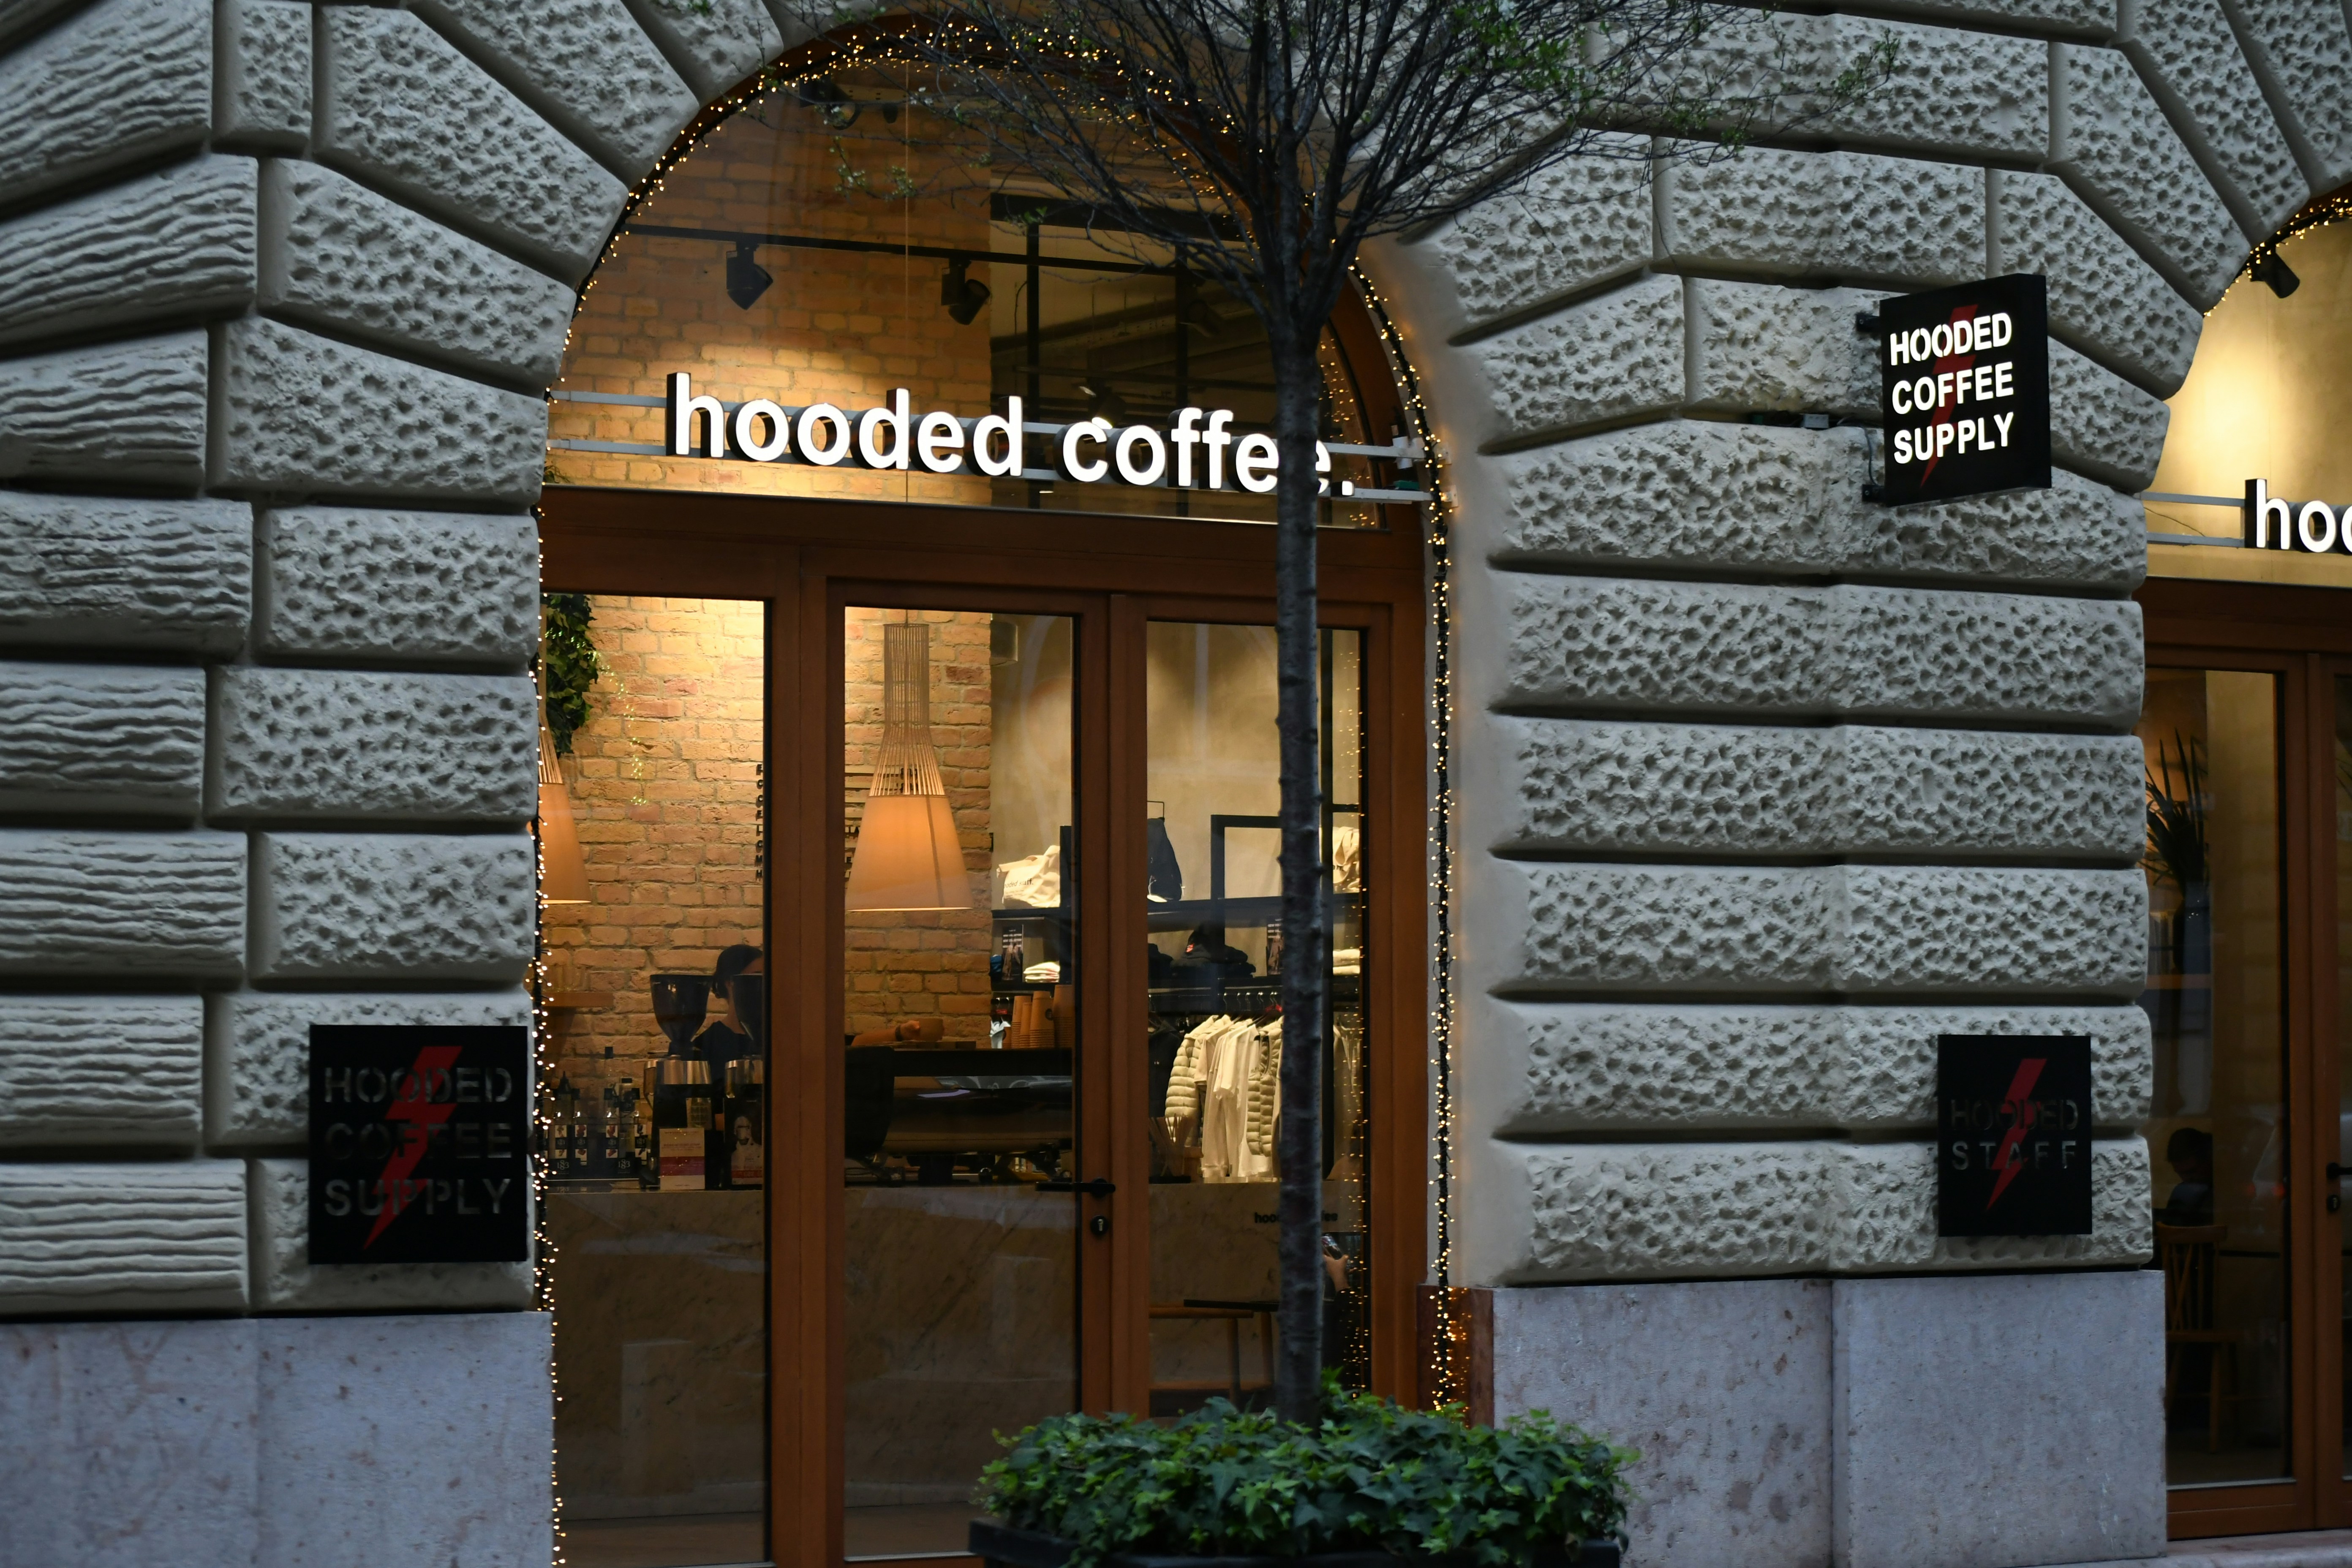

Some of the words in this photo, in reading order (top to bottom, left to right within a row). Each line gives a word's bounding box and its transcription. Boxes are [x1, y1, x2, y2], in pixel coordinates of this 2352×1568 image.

[1890, 312, 2012, 366] HOODED
[1892, 362, 2014, 414] COFFEE
[675, 372, 1022, 477] hooded
[1894, 411, 2014, 464] SUPPLY
[2257, 479, 2352, 553] ho
[324, 1067, 512, 1103] HOODED
[1951, 1099, 2079, 1130] HOODED
[324, 1122, 512, 1160] COFFEE
[1952, 1141, 2076, 1170] STAFF
[324, 1178, 511, 1216] SUPPLY
